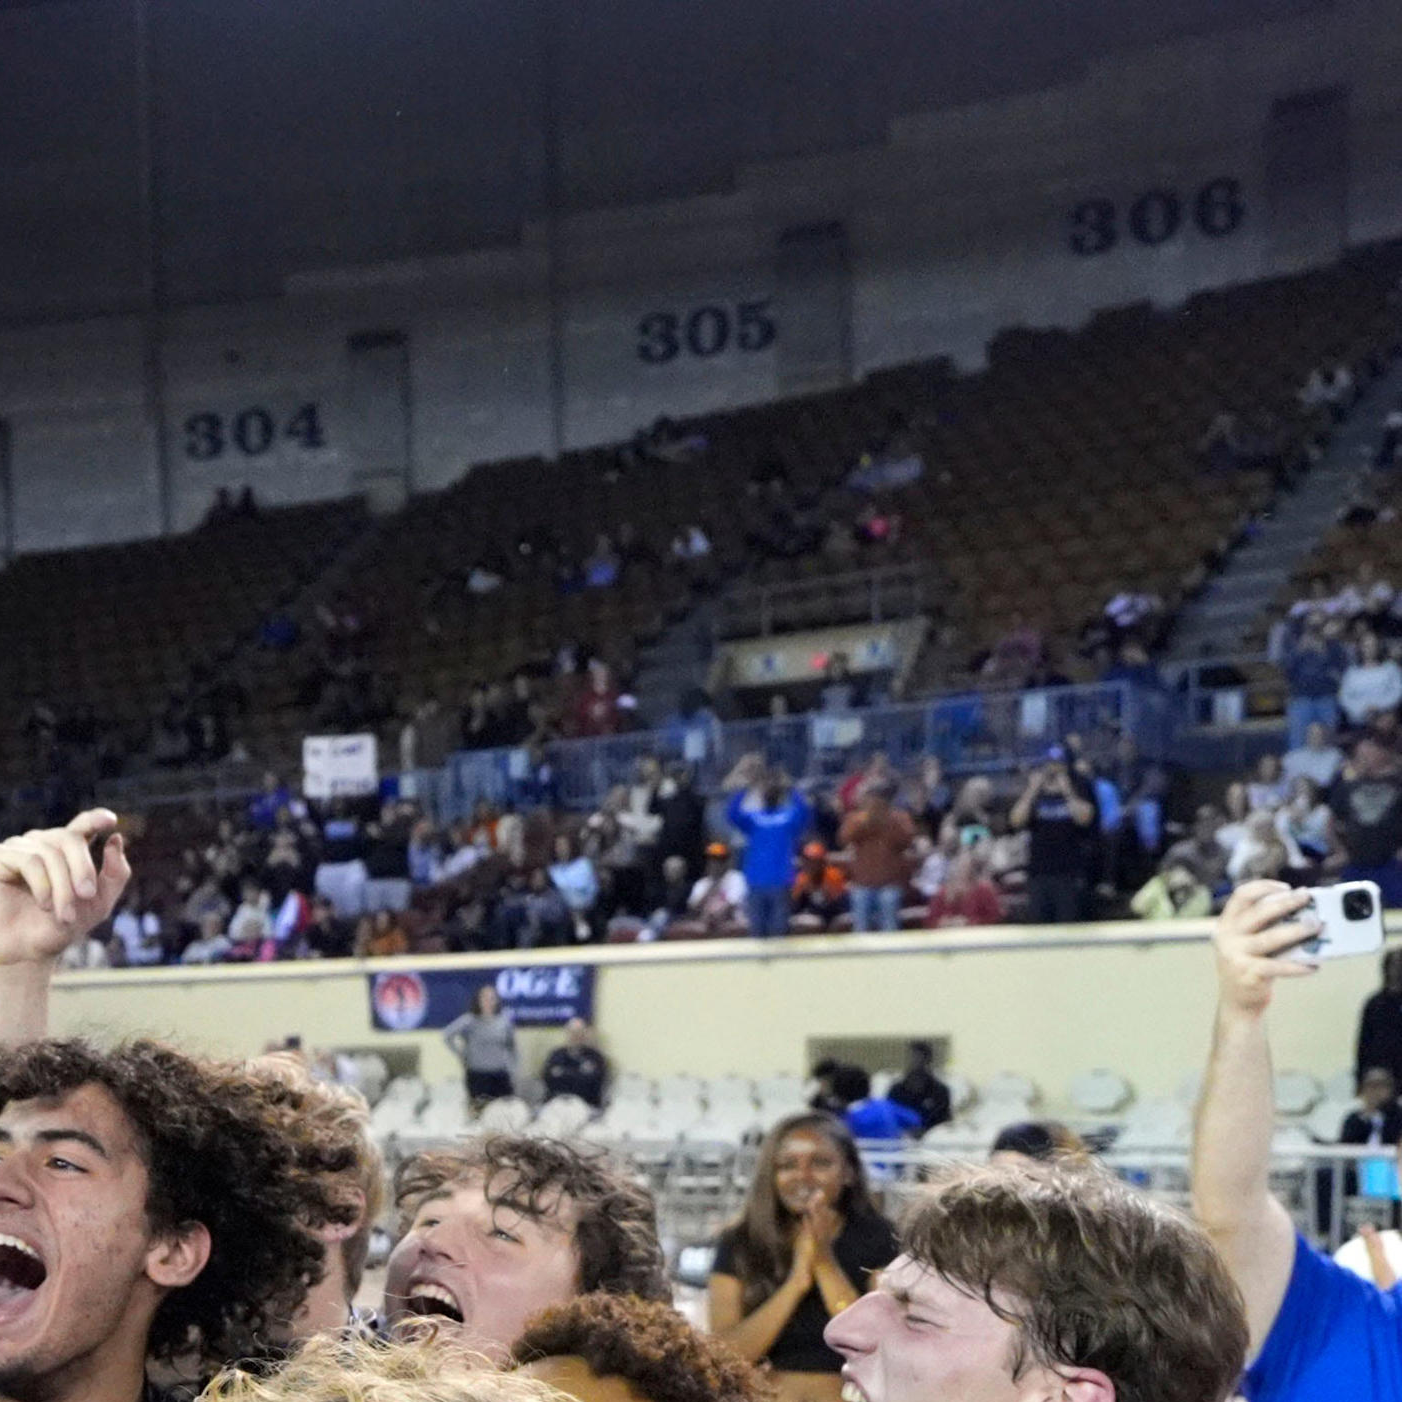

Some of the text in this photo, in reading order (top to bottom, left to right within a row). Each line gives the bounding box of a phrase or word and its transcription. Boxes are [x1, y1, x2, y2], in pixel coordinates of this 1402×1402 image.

[1068, 176, 1244, 256] 306
[636, 300, 777, 365] 305
[183, 403, 325, 461] 304
